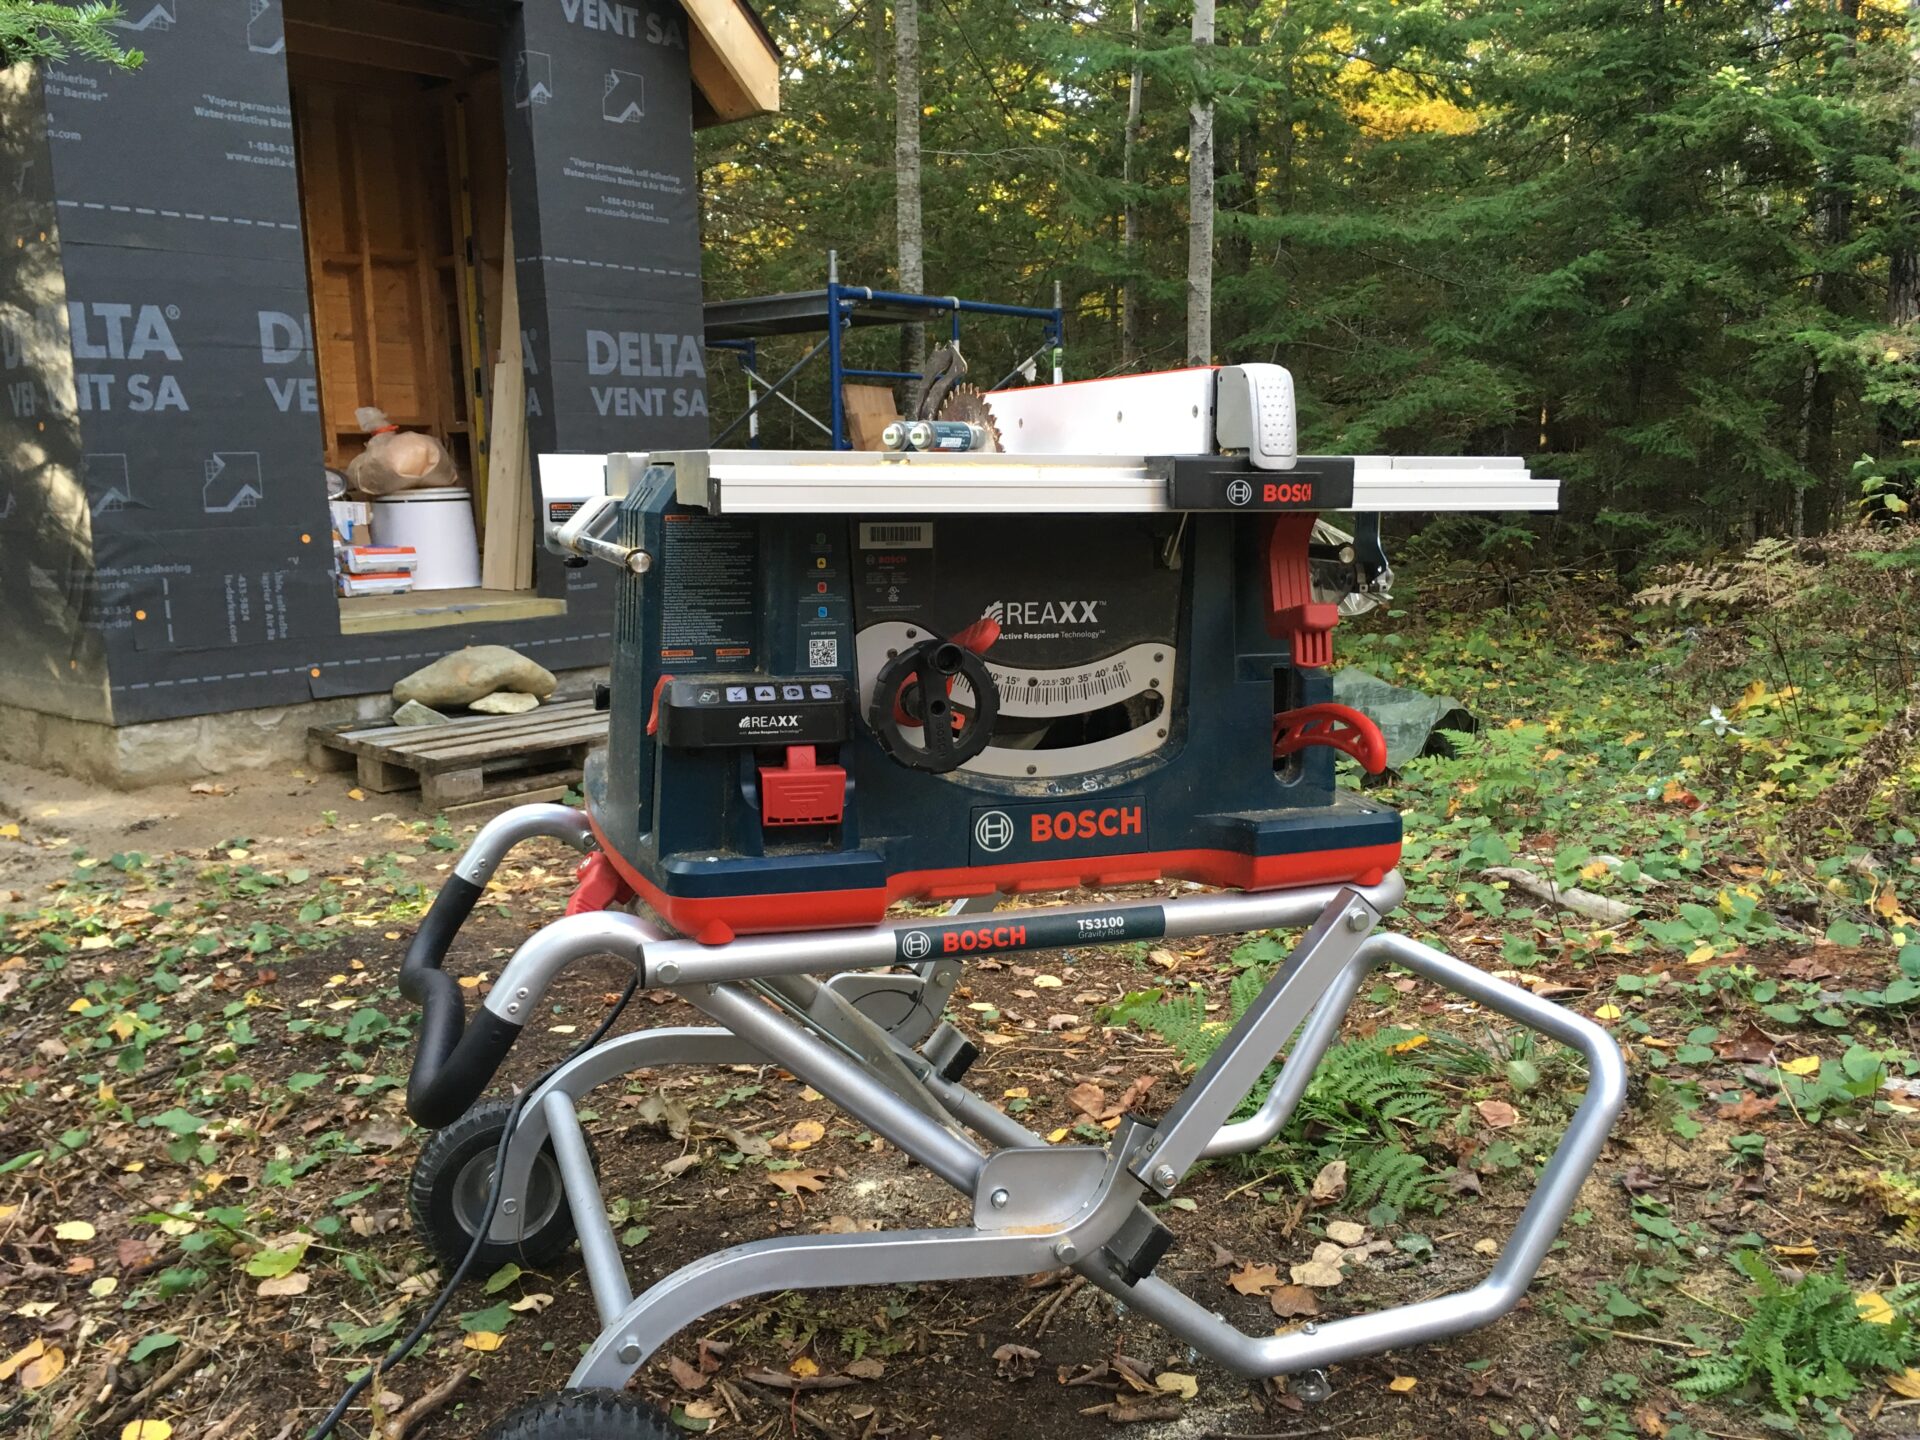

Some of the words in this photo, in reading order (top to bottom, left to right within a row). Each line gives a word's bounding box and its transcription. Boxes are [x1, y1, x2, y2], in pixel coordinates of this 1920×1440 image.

[561, 0, 639, 38] VENT
[646, 13, 685, 49] SA
[127, 373, 190, 412] SA
[590, 386, 667, 417] VENT
[673, 387, 709, 418] SA
[999, 632, 1023, 640] Active
[1023, 631, 1060, 641] Response
[1031, 806, 1143, 842] BOSCH
[943, 925, 1027, 953] BOSCH
[1077, 916, 1124, 931] TS3100
[1078, 929, 1106, 940] Gravity
[1107, 927, 1125, 937] Rise
